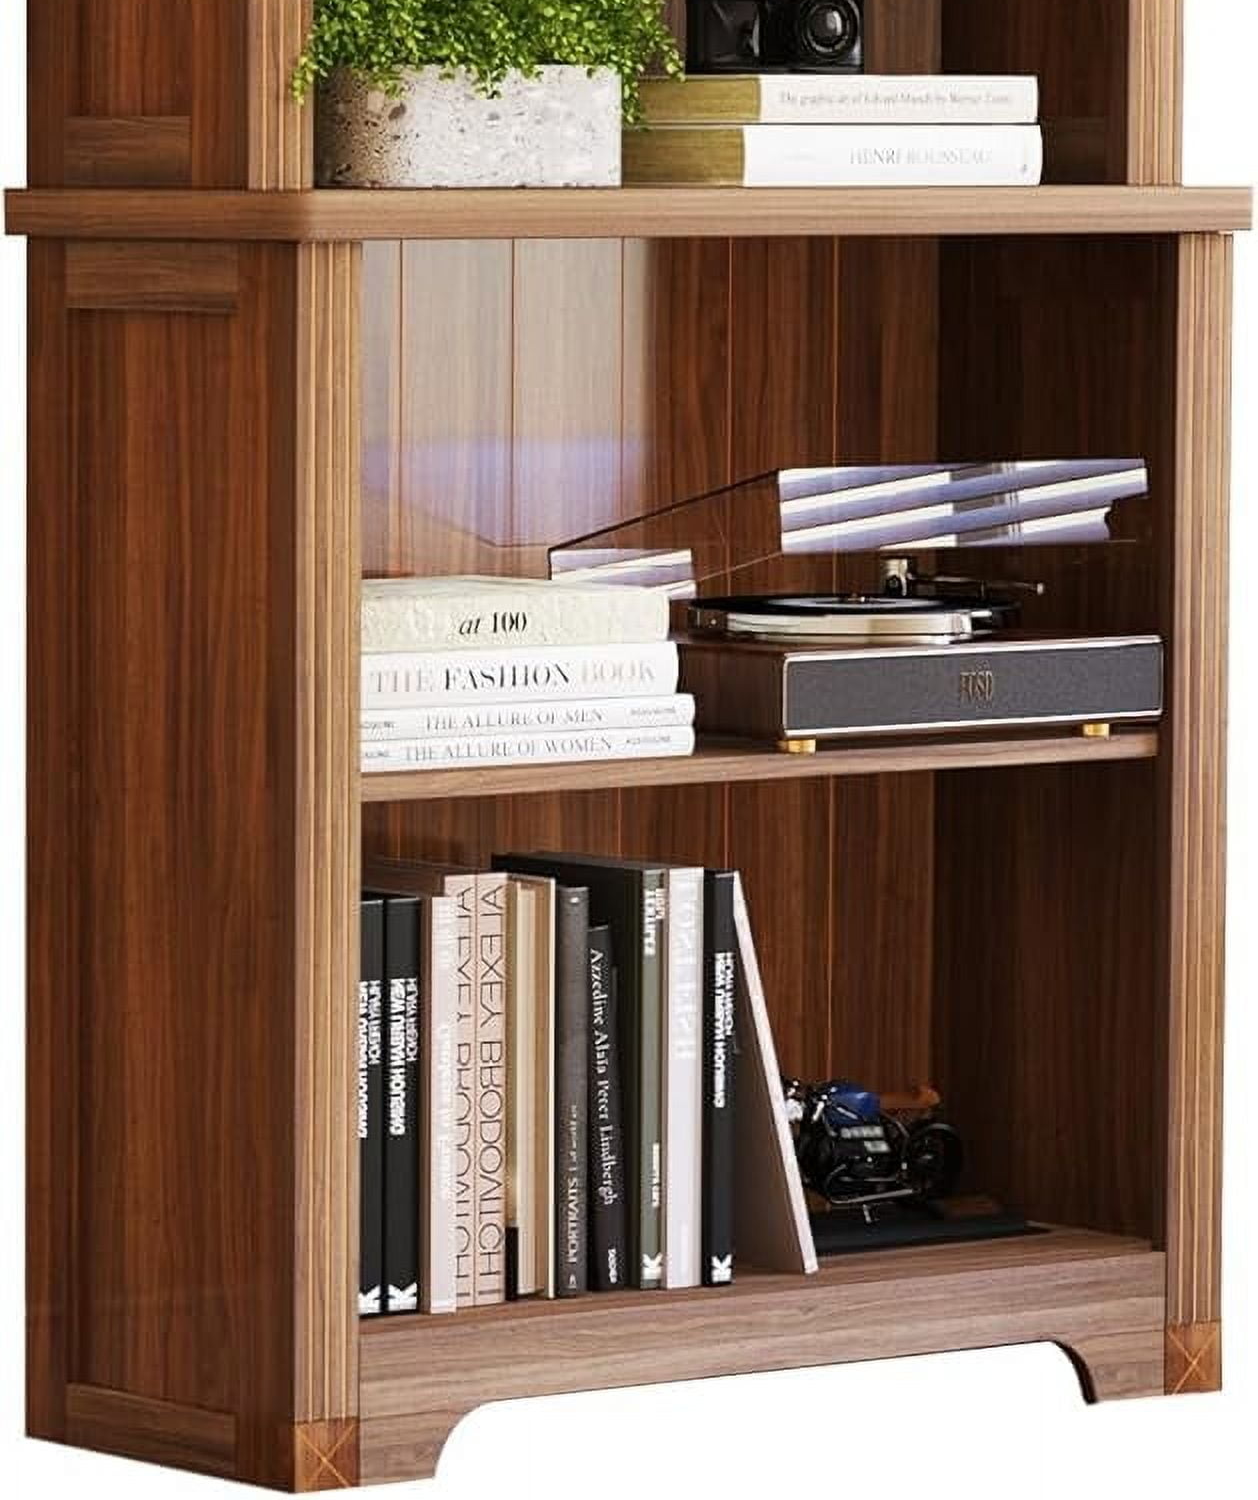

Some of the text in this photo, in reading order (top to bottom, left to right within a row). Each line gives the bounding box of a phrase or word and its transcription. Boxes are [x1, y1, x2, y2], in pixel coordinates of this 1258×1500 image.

[849, 148, 903, 165] HENRI
[458, 610, 528, 636] at 100
[370, 660, 657, 694] THE FASHION BOOK
[425, 706, 603, 732] THE ALLURE OF MEN
[404, 742, 442, 763] THE
[443, 738, 515, 760] ALLURE
[516, 738, 540, 757] OF
[544, 732, 613, 754] WOMEN
[589, 948, 609, 1026] Azzedine
[596, 1079, 611, 1120] Peter
[598, 1124, 619, 1205] Lindbergh
[567, 1177, 579, 1264] PORTRAITS
